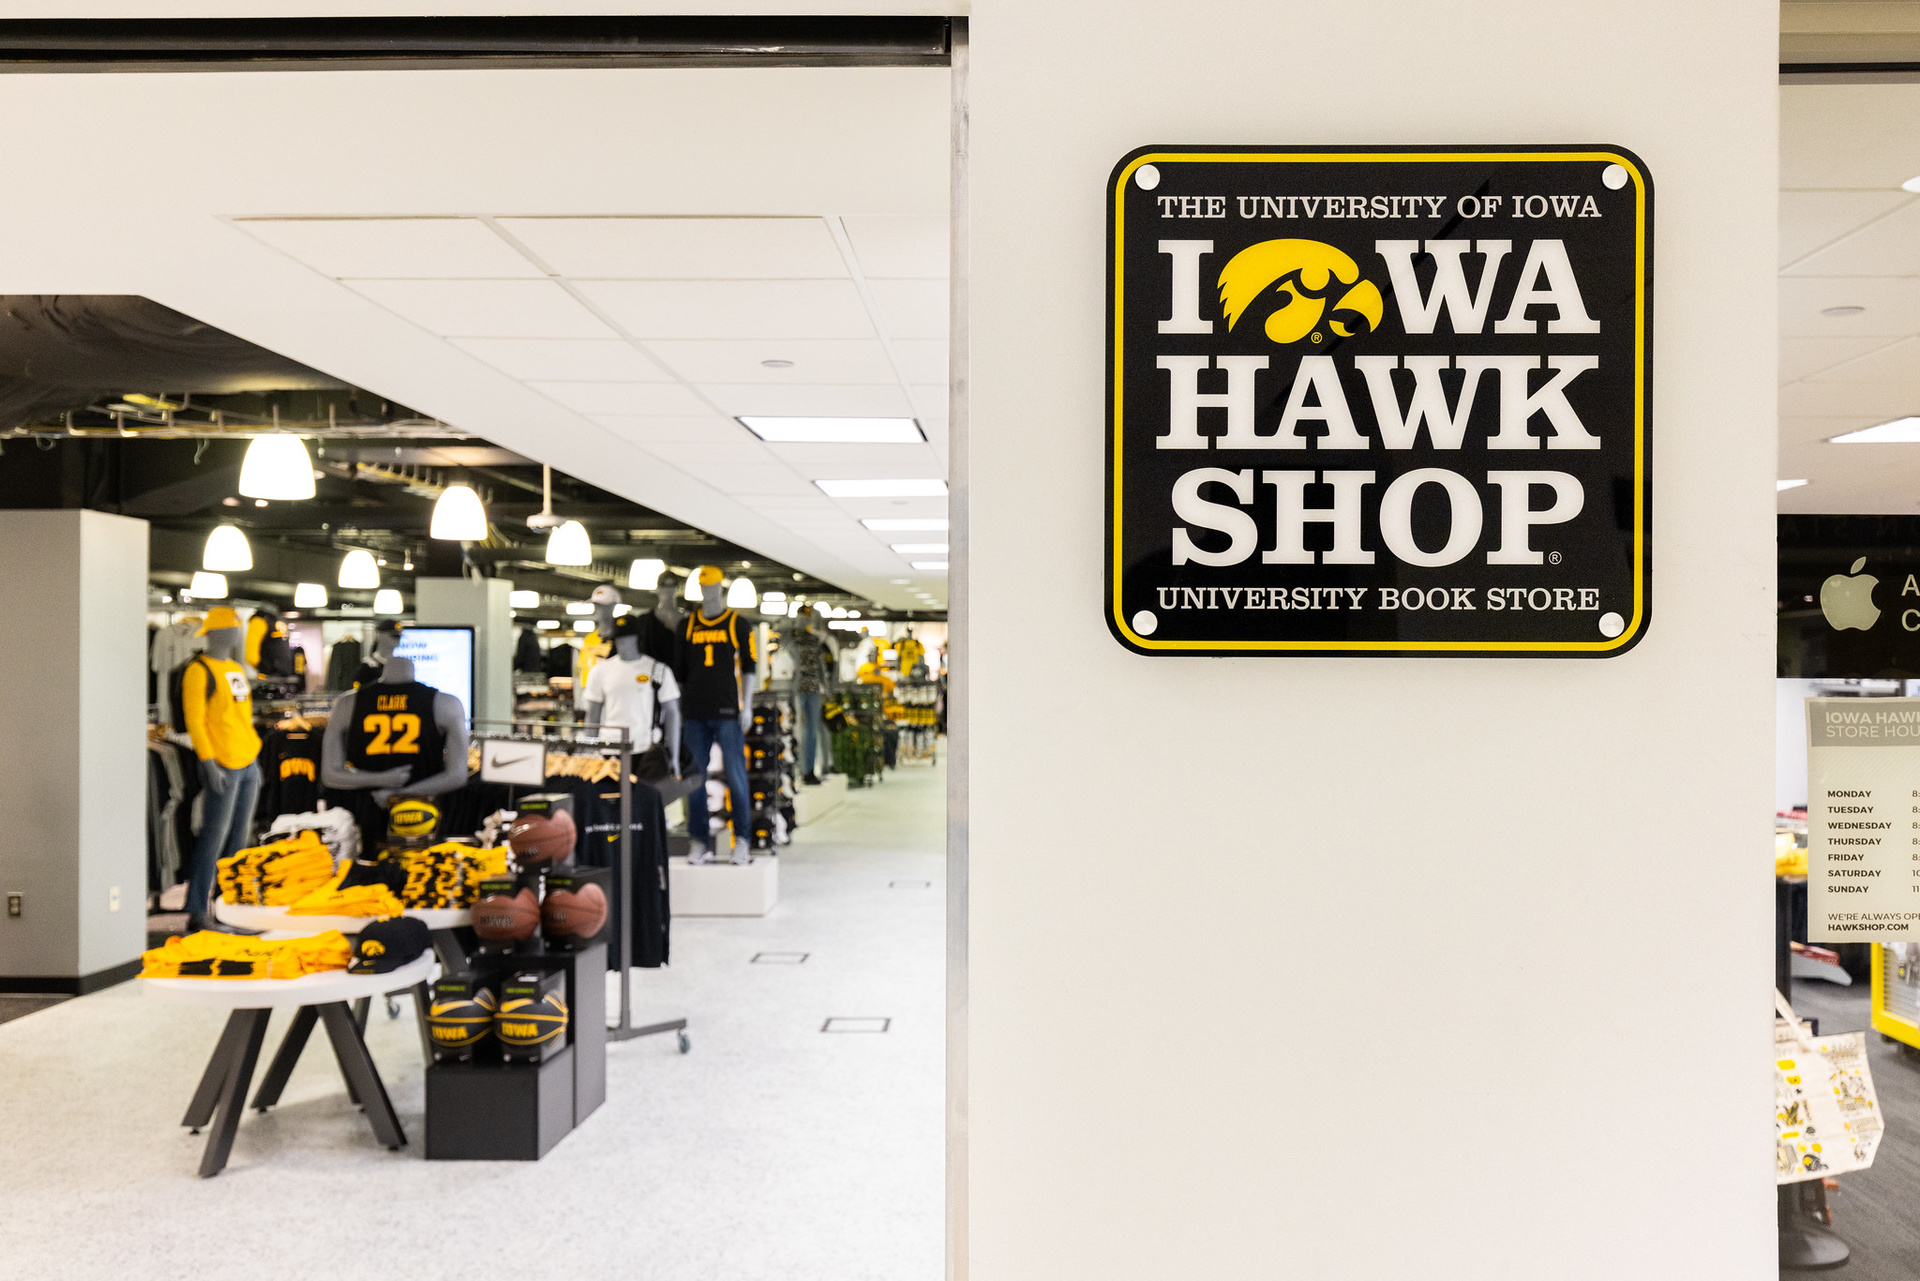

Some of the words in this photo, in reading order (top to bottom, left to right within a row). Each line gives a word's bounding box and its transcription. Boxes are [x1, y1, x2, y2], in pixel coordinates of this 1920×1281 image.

[1157, 195, 1226, 219] THE
[1237, 195, 1447, 219] UNIVERSITY
[1457, 195, 1502, 219] OF
[1511, 194, 1602, 218] IOWA
[1156, 355, 1601, 450] HAWK
[1156, 587, 1368, 611] UNIVERSITY
[1378, 587, 1477, 611] BOOK
[1487, 587, 1601, 612] STORE
[376, 694, 408, 712] CLARK
[1825, 711, 1872, 724] IOWA
[363, 713, 421, 756] 22
[1826, 725, 1880, 738] STORE
[1827, 790, 1872, 798] MONDAY
[1827, 806, 1874, 814] TUESDAY
[1827, 822, 1892, 830] WEDNESDAY
[1827, 838, 1882, 846] THURSDAY
[1827, 853, 1864, 861] FRIDAY
[1827, 869, 1881, 877] SATURDAY
[1827, 885, 1869, 893] SUNDAY
[1828, 913, 1859, 921] WE'RE
[1861, 913, 1902, 921] ALWAYS
[1828, 923, 1909, 931] HAWKSHOP.COM
